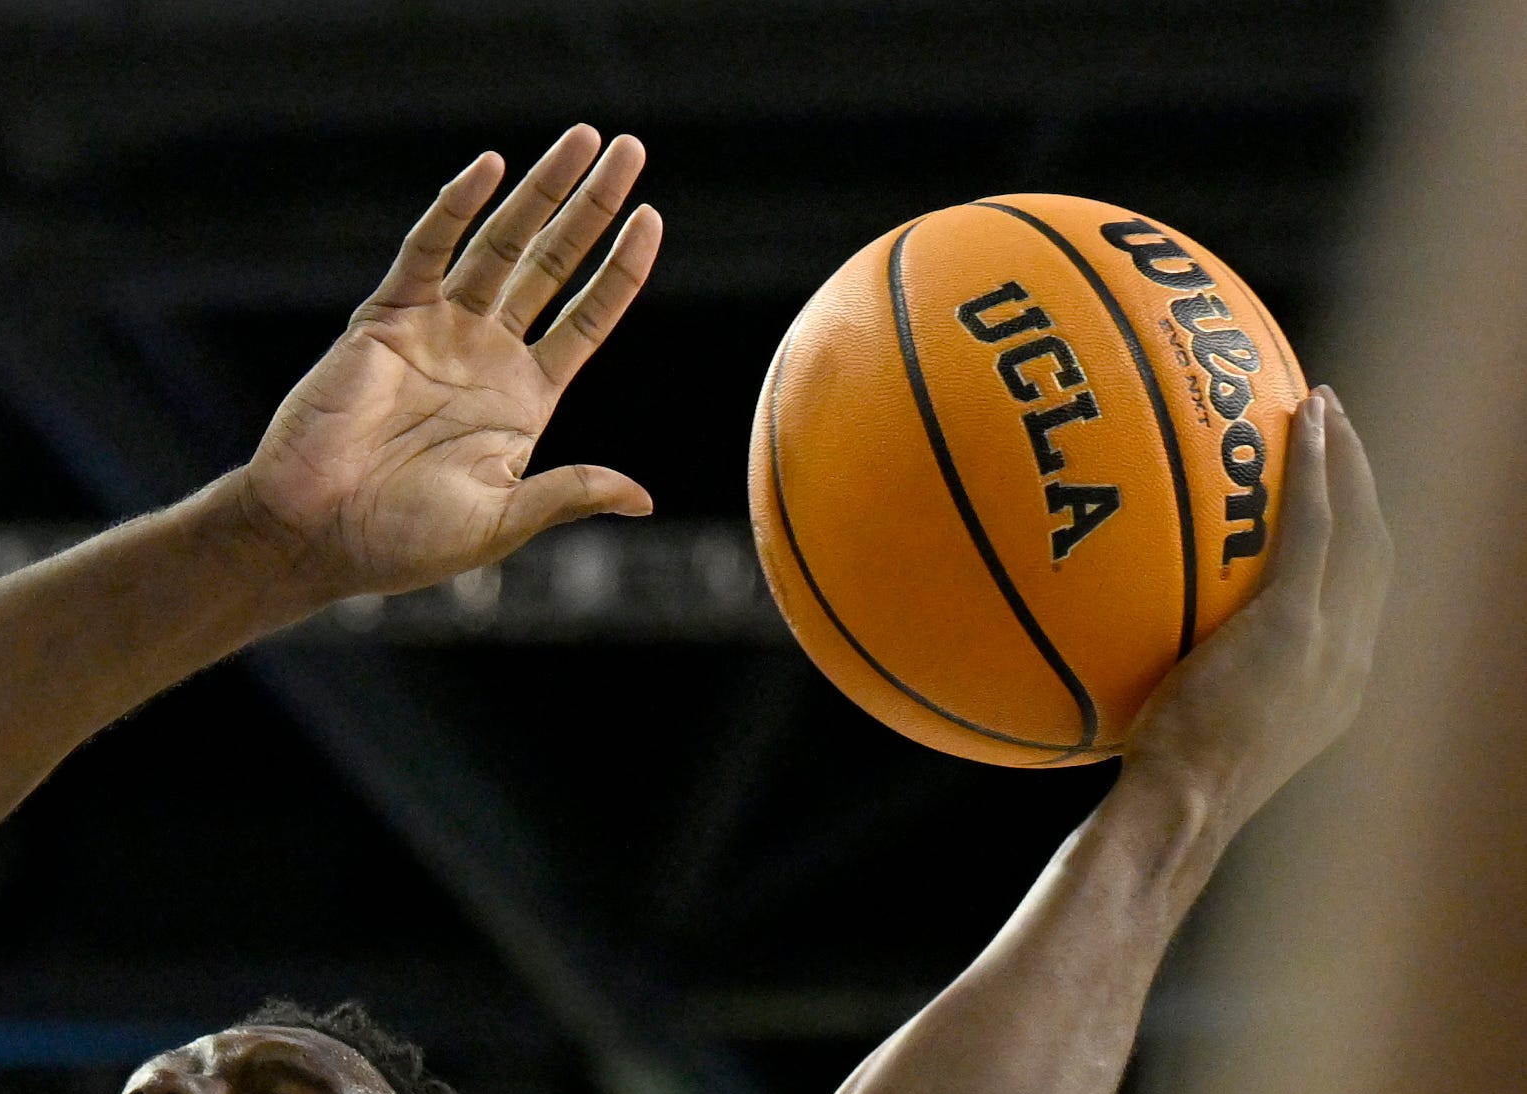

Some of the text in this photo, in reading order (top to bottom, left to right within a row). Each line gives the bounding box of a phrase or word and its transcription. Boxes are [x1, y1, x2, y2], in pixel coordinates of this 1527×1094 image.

[955, 280, 1122, 561] UCLA
[1100, 217, 1269, 568] Wilson
[1186, 375, 1211, 428] NXT
